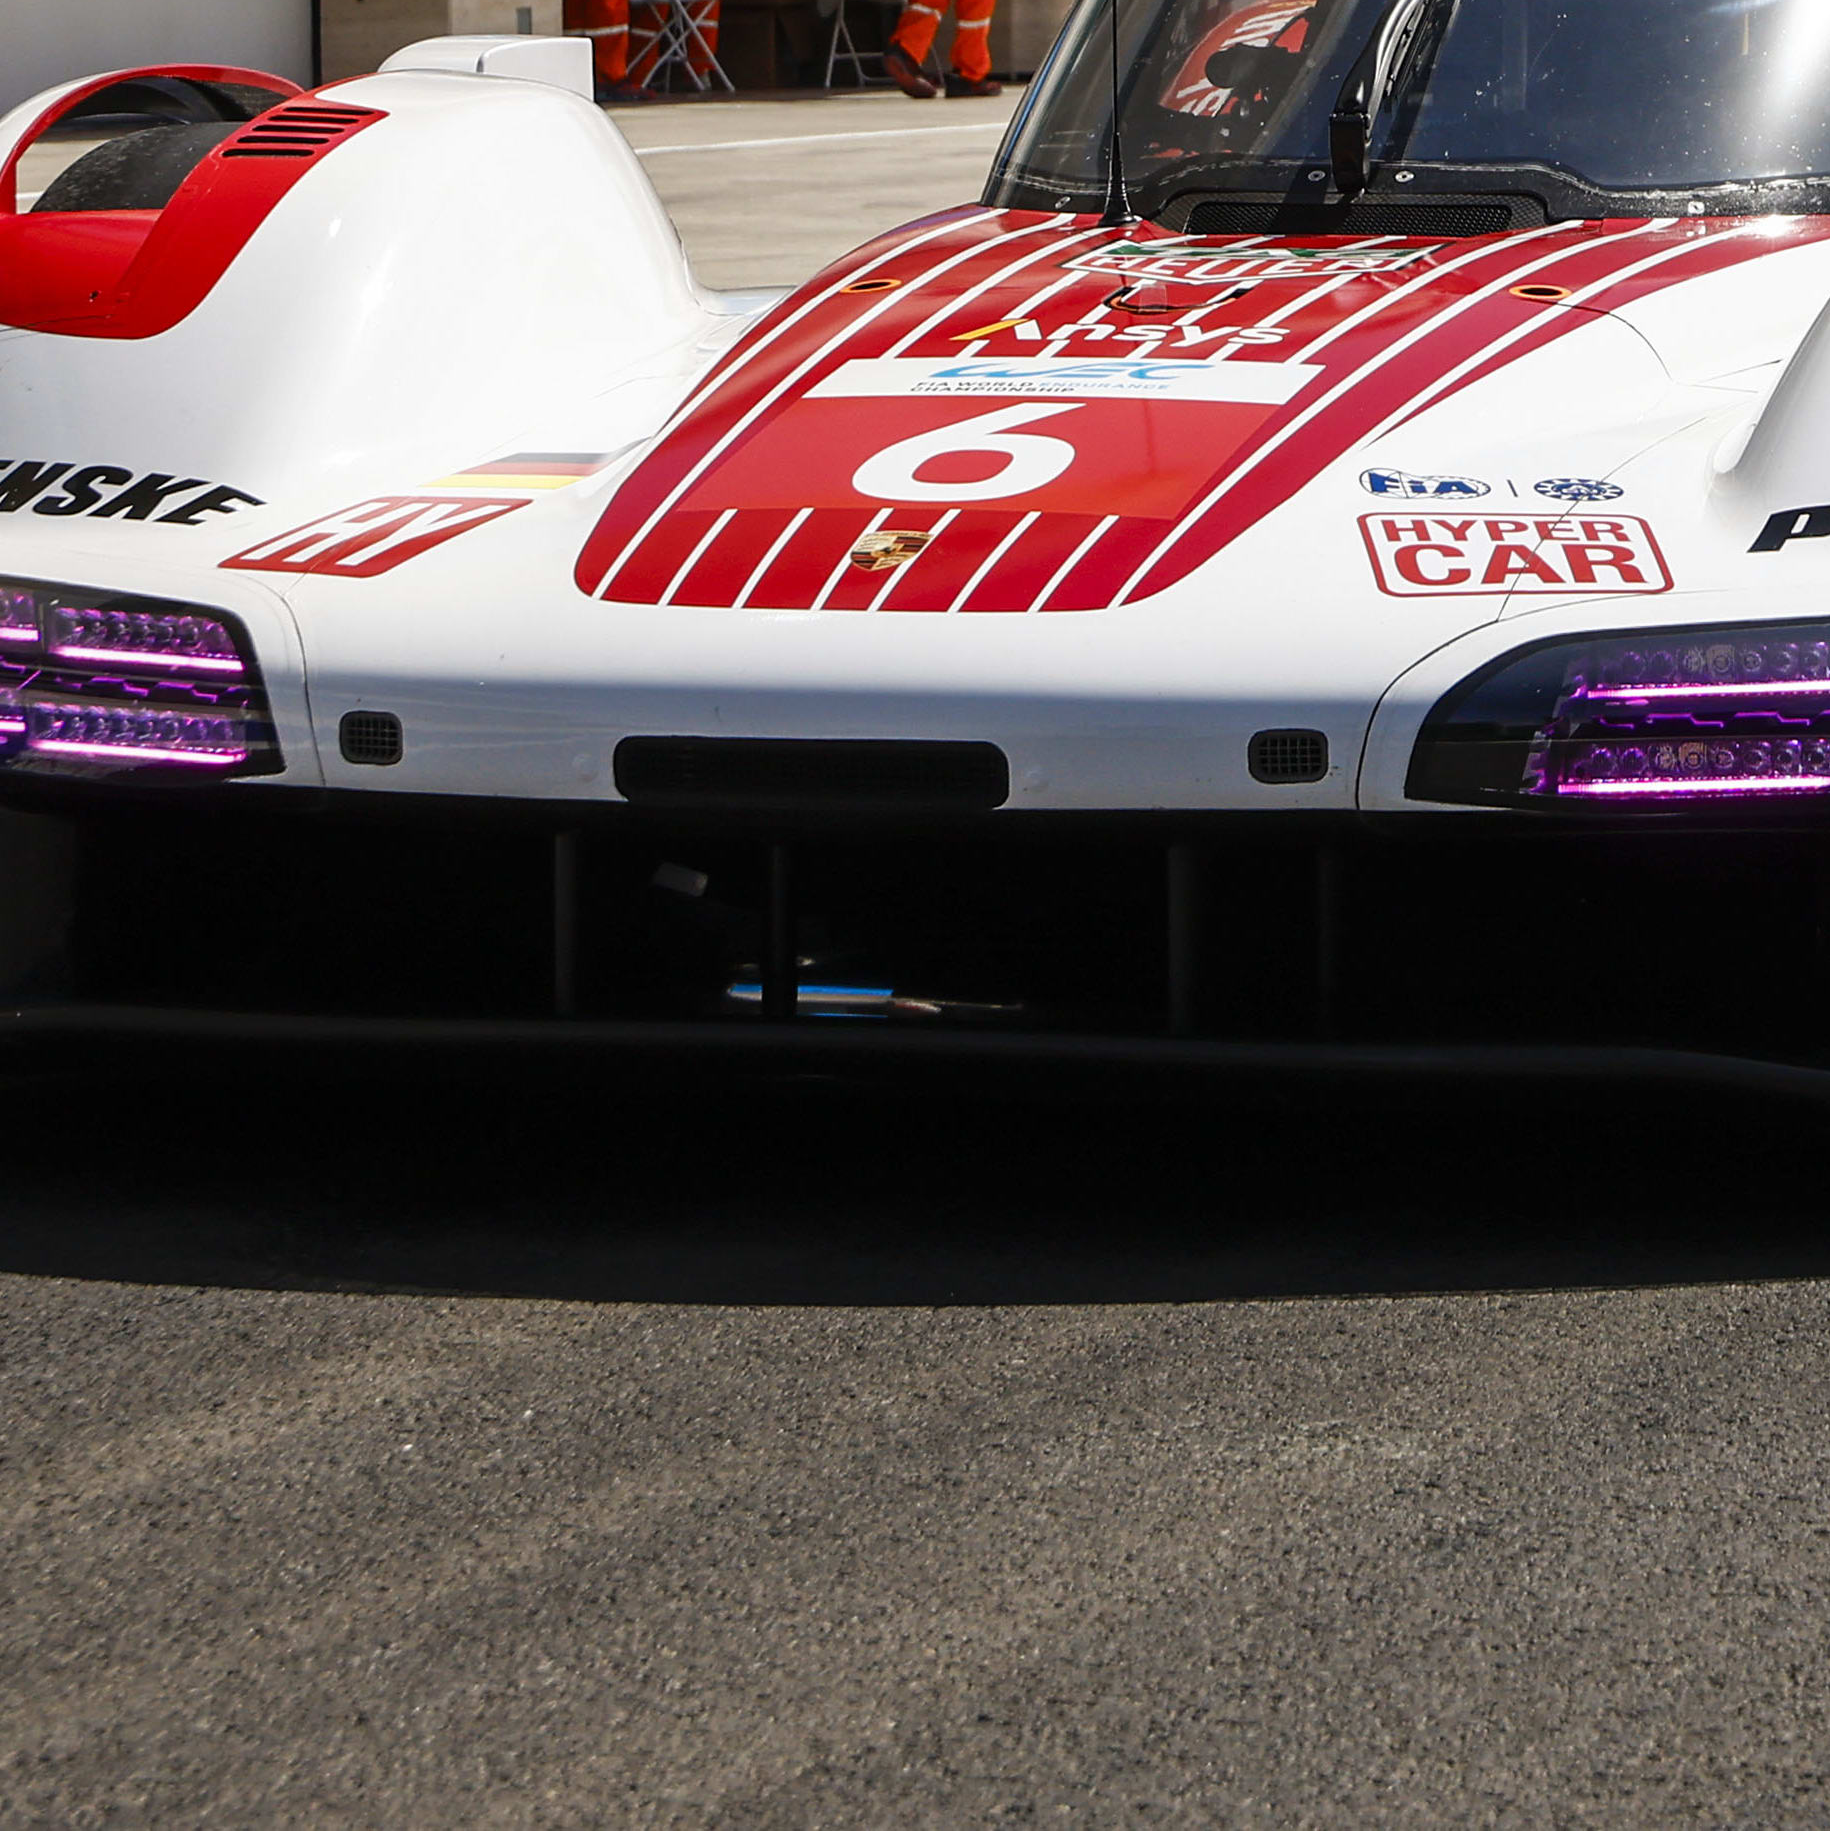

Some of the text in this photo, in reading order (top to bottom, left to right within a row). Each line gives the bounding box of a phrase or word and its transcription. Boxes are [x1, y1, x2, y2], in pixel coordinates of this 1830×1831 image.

[1091, 256, 1386, 279] HEUER
[948, 318, 1291, 347] Ansys
[929, 361, 1215, 380] WEC
[1038, 382, 1172, 390] ENDURANCE
[851, 401, 1087, 502] 6
[0, 458, 267, 526] NSKE
[1368, 471, 1480, 495] FIA
[238, 499, 512, 568] HY
[1380, 519, 1632, 542] HYPER
[1393, 543, 1648, 586] CAR
